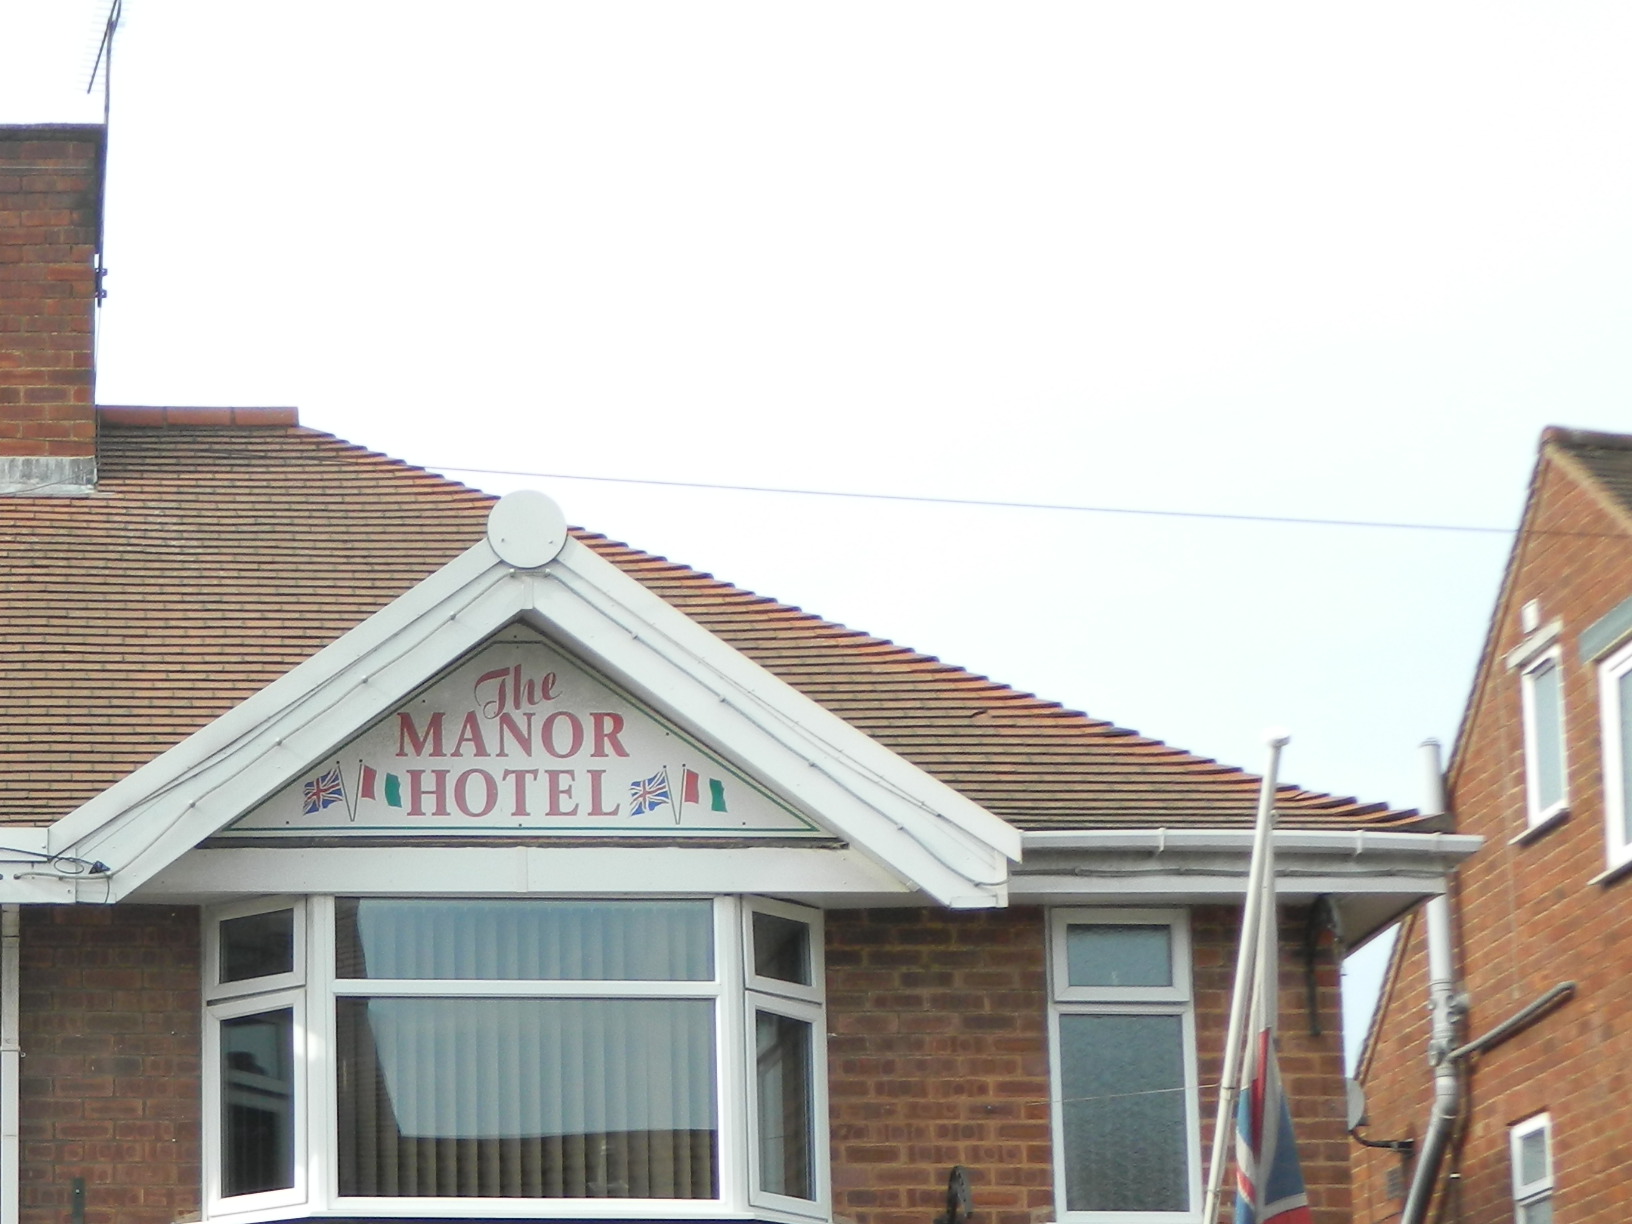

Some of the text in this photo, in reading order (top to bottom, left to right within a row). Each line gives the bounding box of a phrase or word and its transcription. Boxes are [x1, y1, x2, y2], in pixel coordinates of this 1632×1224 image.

[474, 663, 563, 720] The
[395, 711, 630, 759] MANOR
[406, 768, 621, 819] HOTEL
